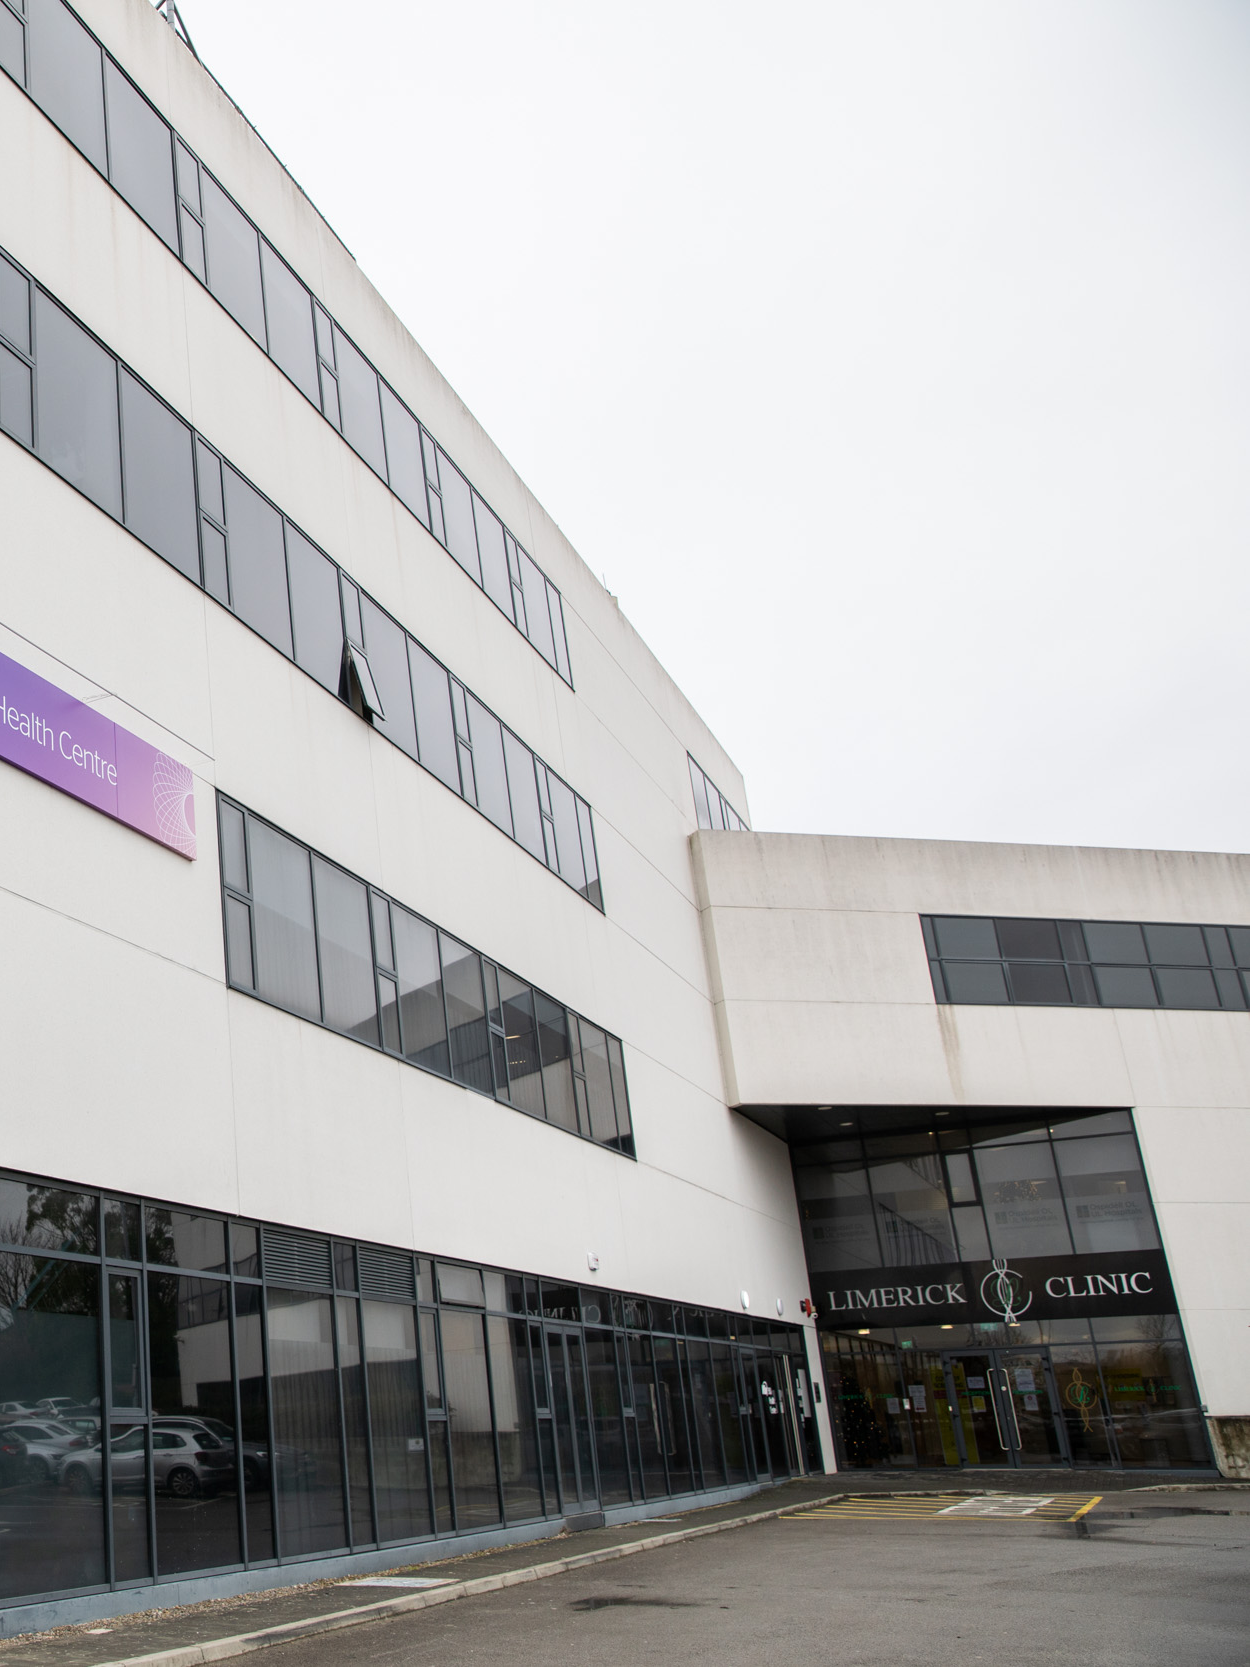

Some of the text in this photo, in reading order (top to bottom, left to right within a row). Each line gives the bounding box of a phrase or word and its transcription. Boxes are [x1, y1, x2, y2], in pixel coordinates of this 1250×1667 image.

[59, 730, 118, 786] Centre
[827, 1271, 1154, 1311] LIMERICK CLINIC
